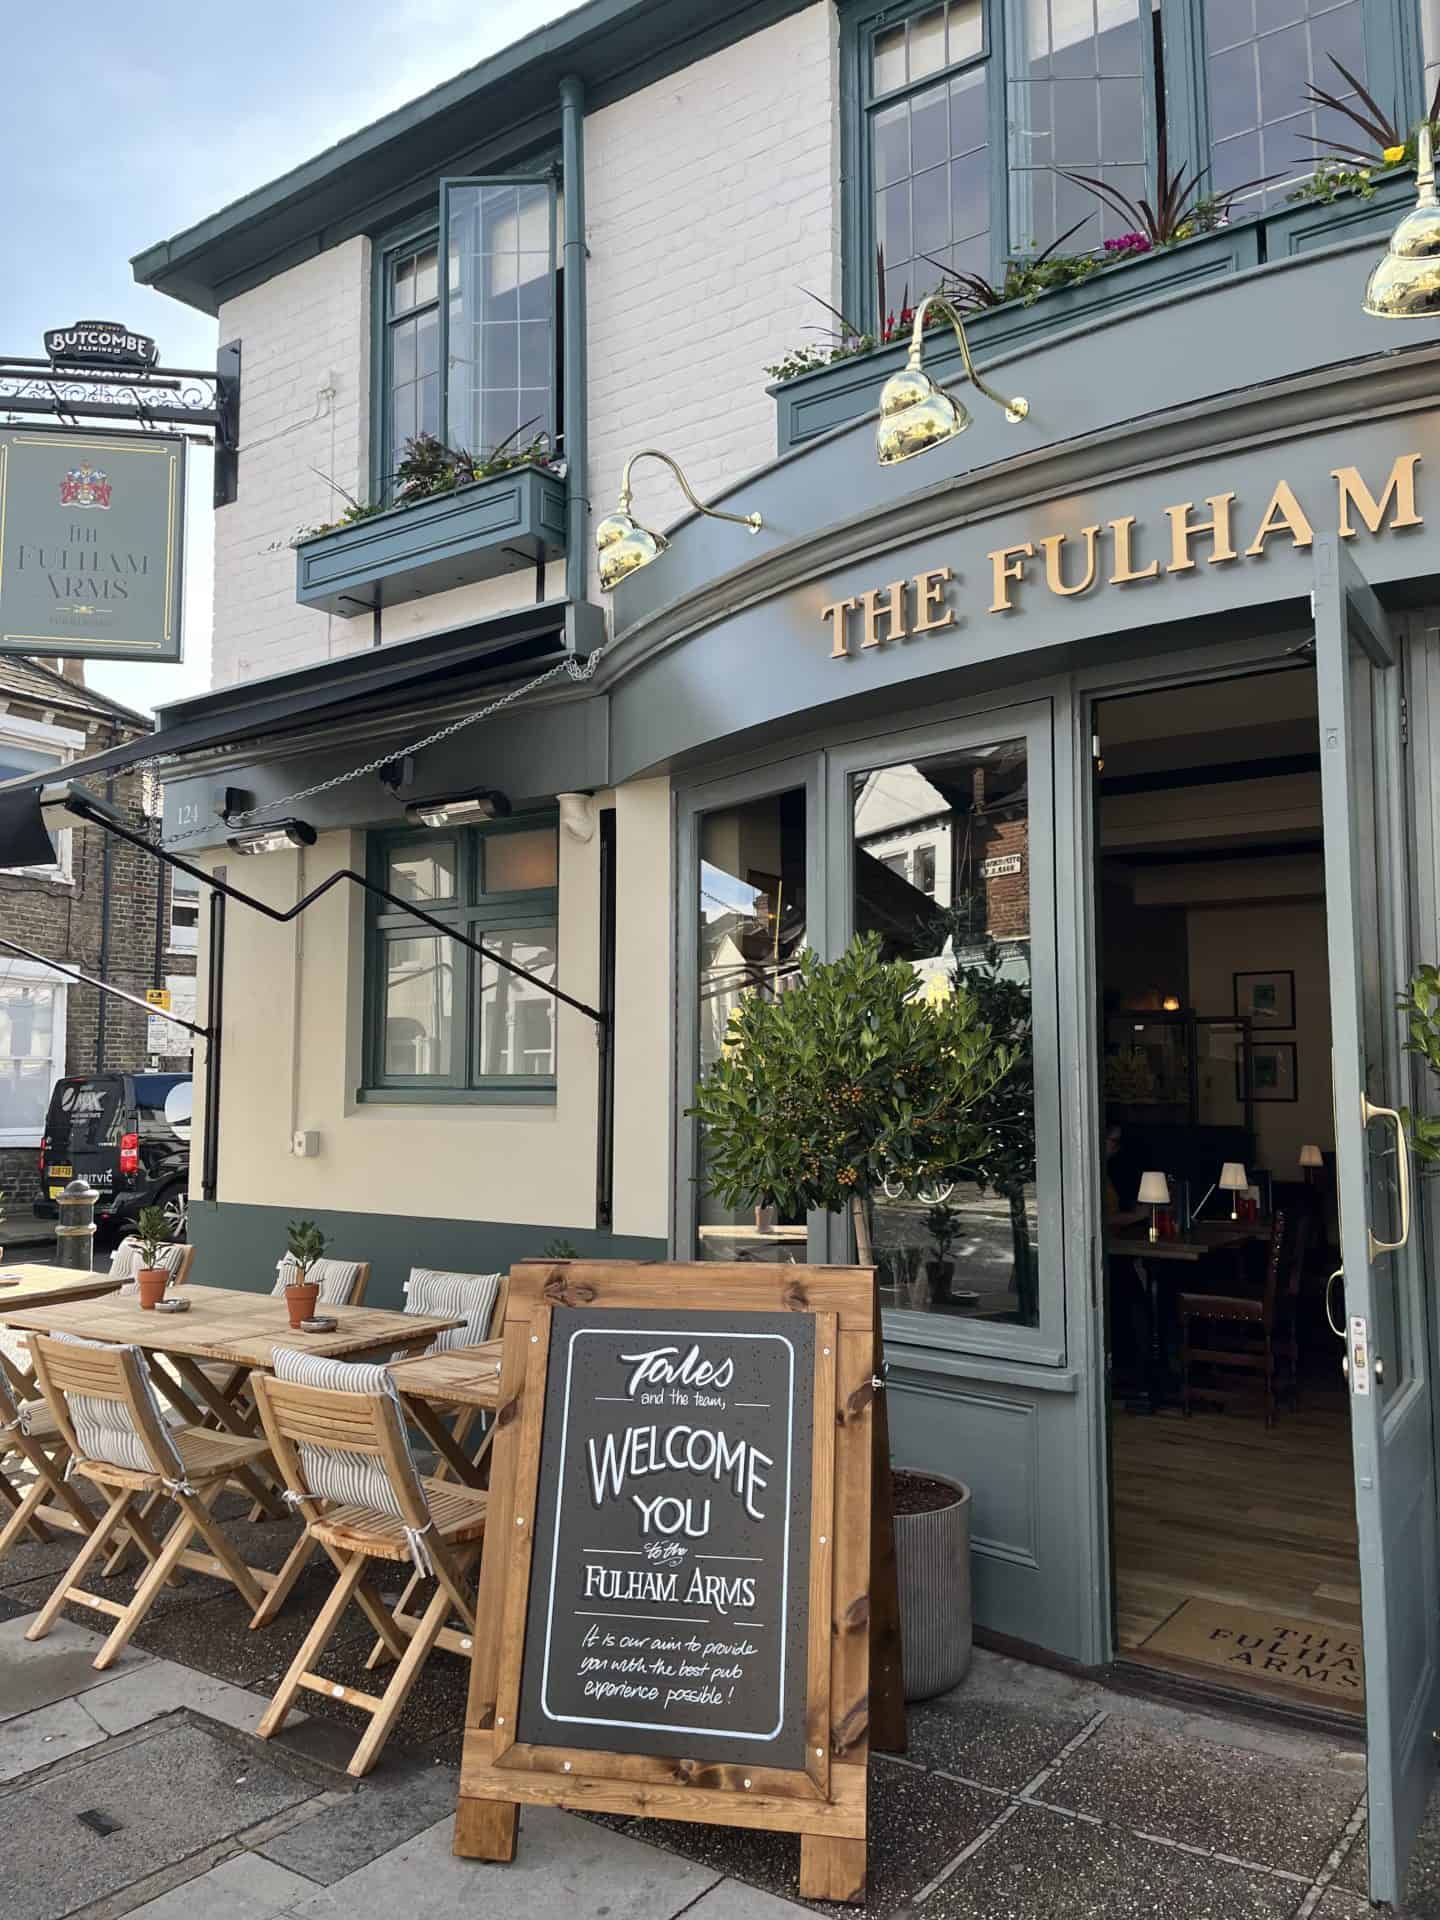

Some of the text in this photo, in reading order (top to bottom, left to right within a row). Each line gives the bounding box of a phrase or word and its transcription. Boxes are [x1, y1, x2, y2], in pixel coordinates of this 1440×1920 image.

[49, 331, 147, 358] BUTCOMBE
[820, 452, 1424, 660] THE FULHAM
[47, 573, 129, 600] ARMS
[177, 803, 199, 825] 124
[620, 1344, 734, 1395] Tales
[641, 1388, 726, 1410] and the team,
[588, 1425, 774, 1520] WELCOME
[632, 1495, 711, 1537] YOU
[643, 1540, 689, 1560] to the
[583, 1564, 756, 1615] FULHAM ARMS
[581, 1623, 759, 1658] It is our aim to provide
[1208, 1627, 1360, 1672] FULHA
[1272, 1626, 1361, 1656] THE
[576, 1656, 744, 1683] you with the best pub
[1228, 1651, 1361, 1688] ARMS
[583, 1679, 660, 1700] experience
